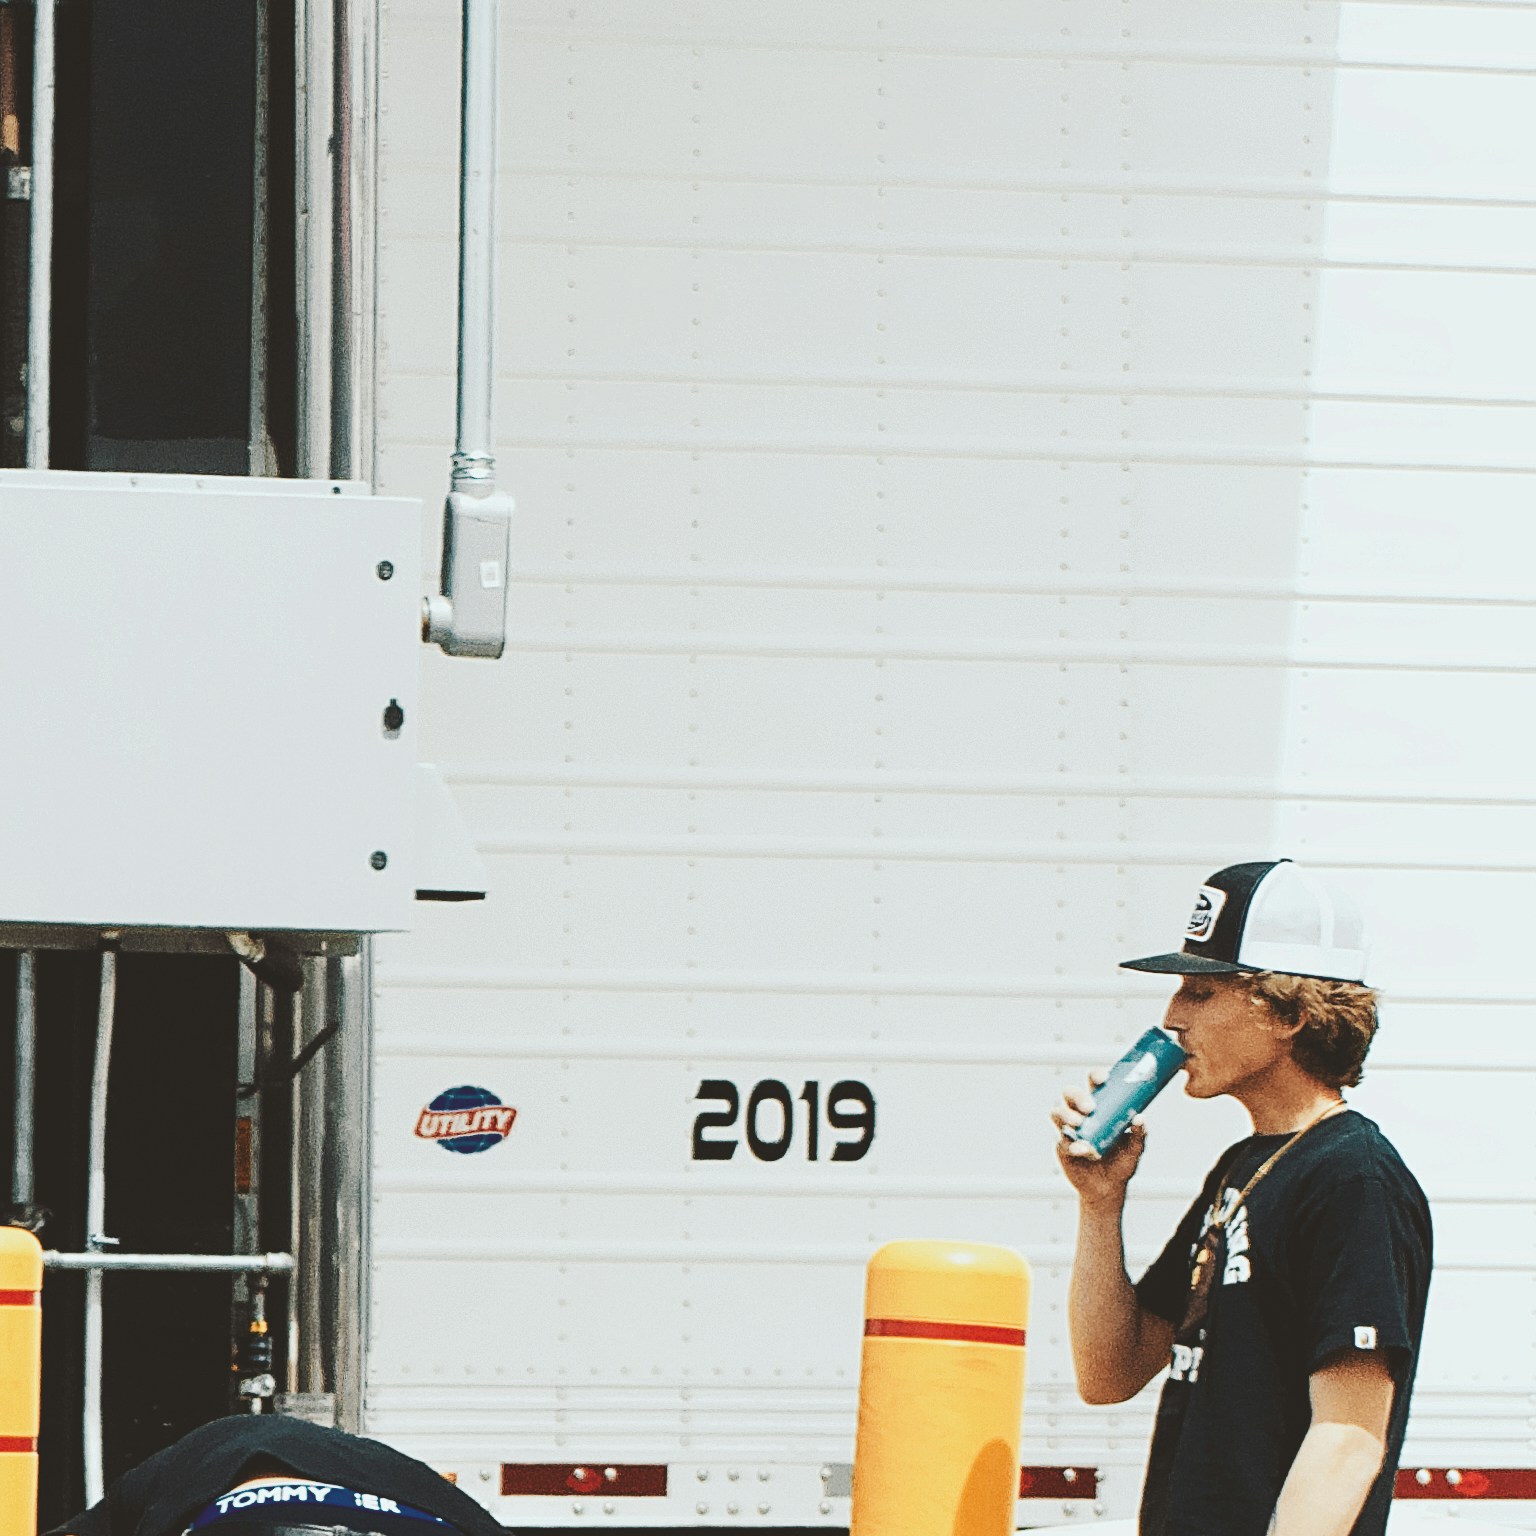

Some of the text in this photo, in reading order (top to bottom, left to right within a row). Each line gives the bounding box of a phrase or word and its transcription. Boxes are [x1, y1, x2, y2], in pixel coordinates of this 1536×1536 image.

[419, 1108, 511, 1136] UTILITY
[691, 1078, 877, 1162] 2019
[215, 1484, 332, 1514] TOMMY
